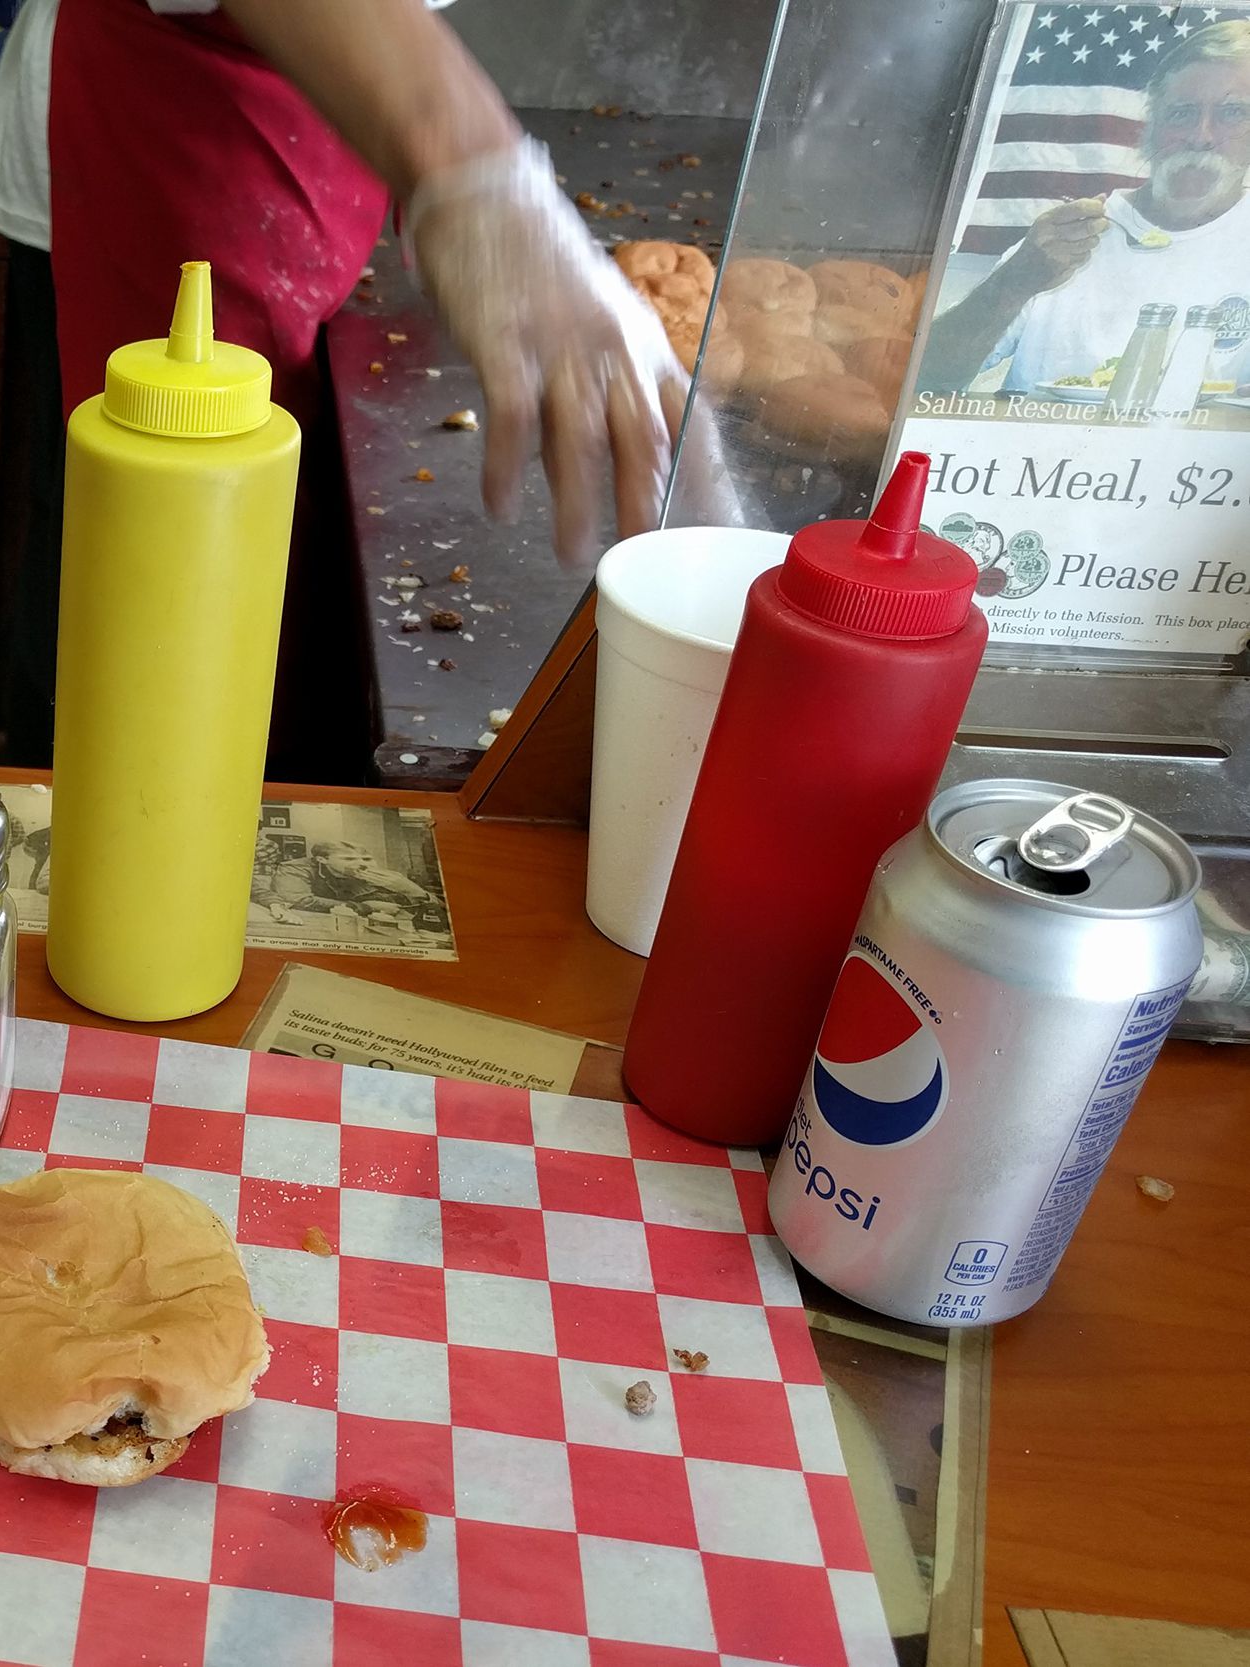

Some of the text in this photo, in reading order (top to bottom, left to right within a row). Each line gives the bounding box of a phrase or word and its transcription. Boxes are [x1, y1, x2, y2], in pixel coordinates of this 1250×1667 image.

[915, 391, 1211, 426] Salina Rescue Mission
[927, 453, 1250, 510] Hot Meal, $2.
[1053, 554, 1250, 596] Please He
[988, 606, 1040, 621] directly
[1044, 610, 1057, 620] to
[1061, 610, 1083, 622] the
[1086, 611, 1145, 625] Mission.
[1155, 615, 1184, 628] This
[1188, 616, 1213, 629] box
[991, 622, 1125, 641] Mission volunteers.
[363, 945, 386, 953] Cozy
[860, 934, 932, 1010] ASPARTAME FREE
[284, 1019, 300, 1028] its
[301, 1024, 331, 1037] taste
[366, 1042, 388, 1053] for
[390, 1048, 406, 1058] 75
[446, 1063, 465, 1074] it's
[467, 1069, 494, 1082] had
[288, 1009, 330, 1026] Salina
[331, 1022, 374, 1038] doesn't
[376, 1034, 407, 1046] need
[408, 1042, 480, 1066] Hollywood
[479, 1062, 507, 1075] film
[512, 1070, 524, 1079] to
[524, 1075, 555, 1088] feed
[785, 1116, 881, 1230] pepsi
[952, 1263, 996, 1273] CALORIES
[973, 1249, 988, 1263] 0
[928, 1305, 981, 1320] (355 mL)
[936, 1293, 986, 1306] 12 FL OZ
